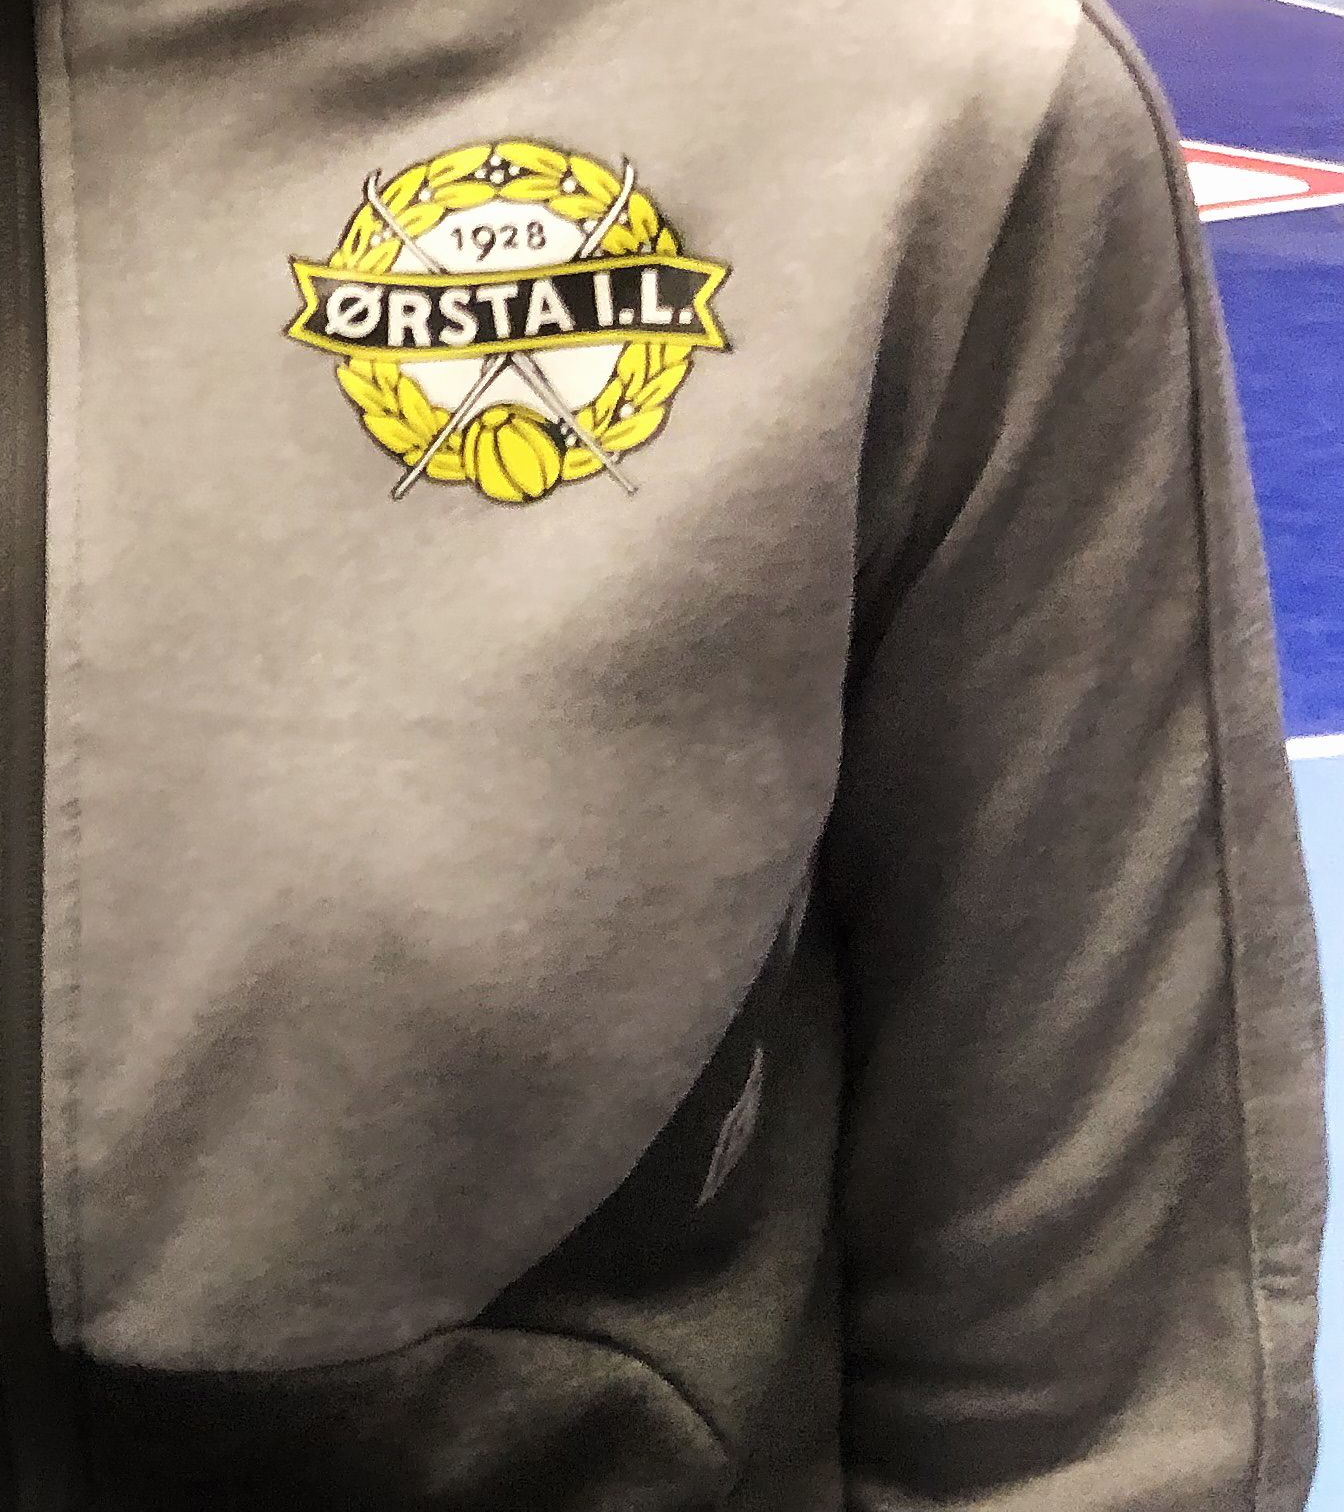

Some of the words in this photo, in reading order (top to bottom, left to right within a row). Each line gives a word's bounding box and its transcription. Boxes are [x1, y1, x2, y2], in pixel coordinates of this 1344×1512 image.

[450, 220, 548, 262] 1928
[325, 276, 576, 347] ØRSTA
[591, 266, 695, 328] I.L.
